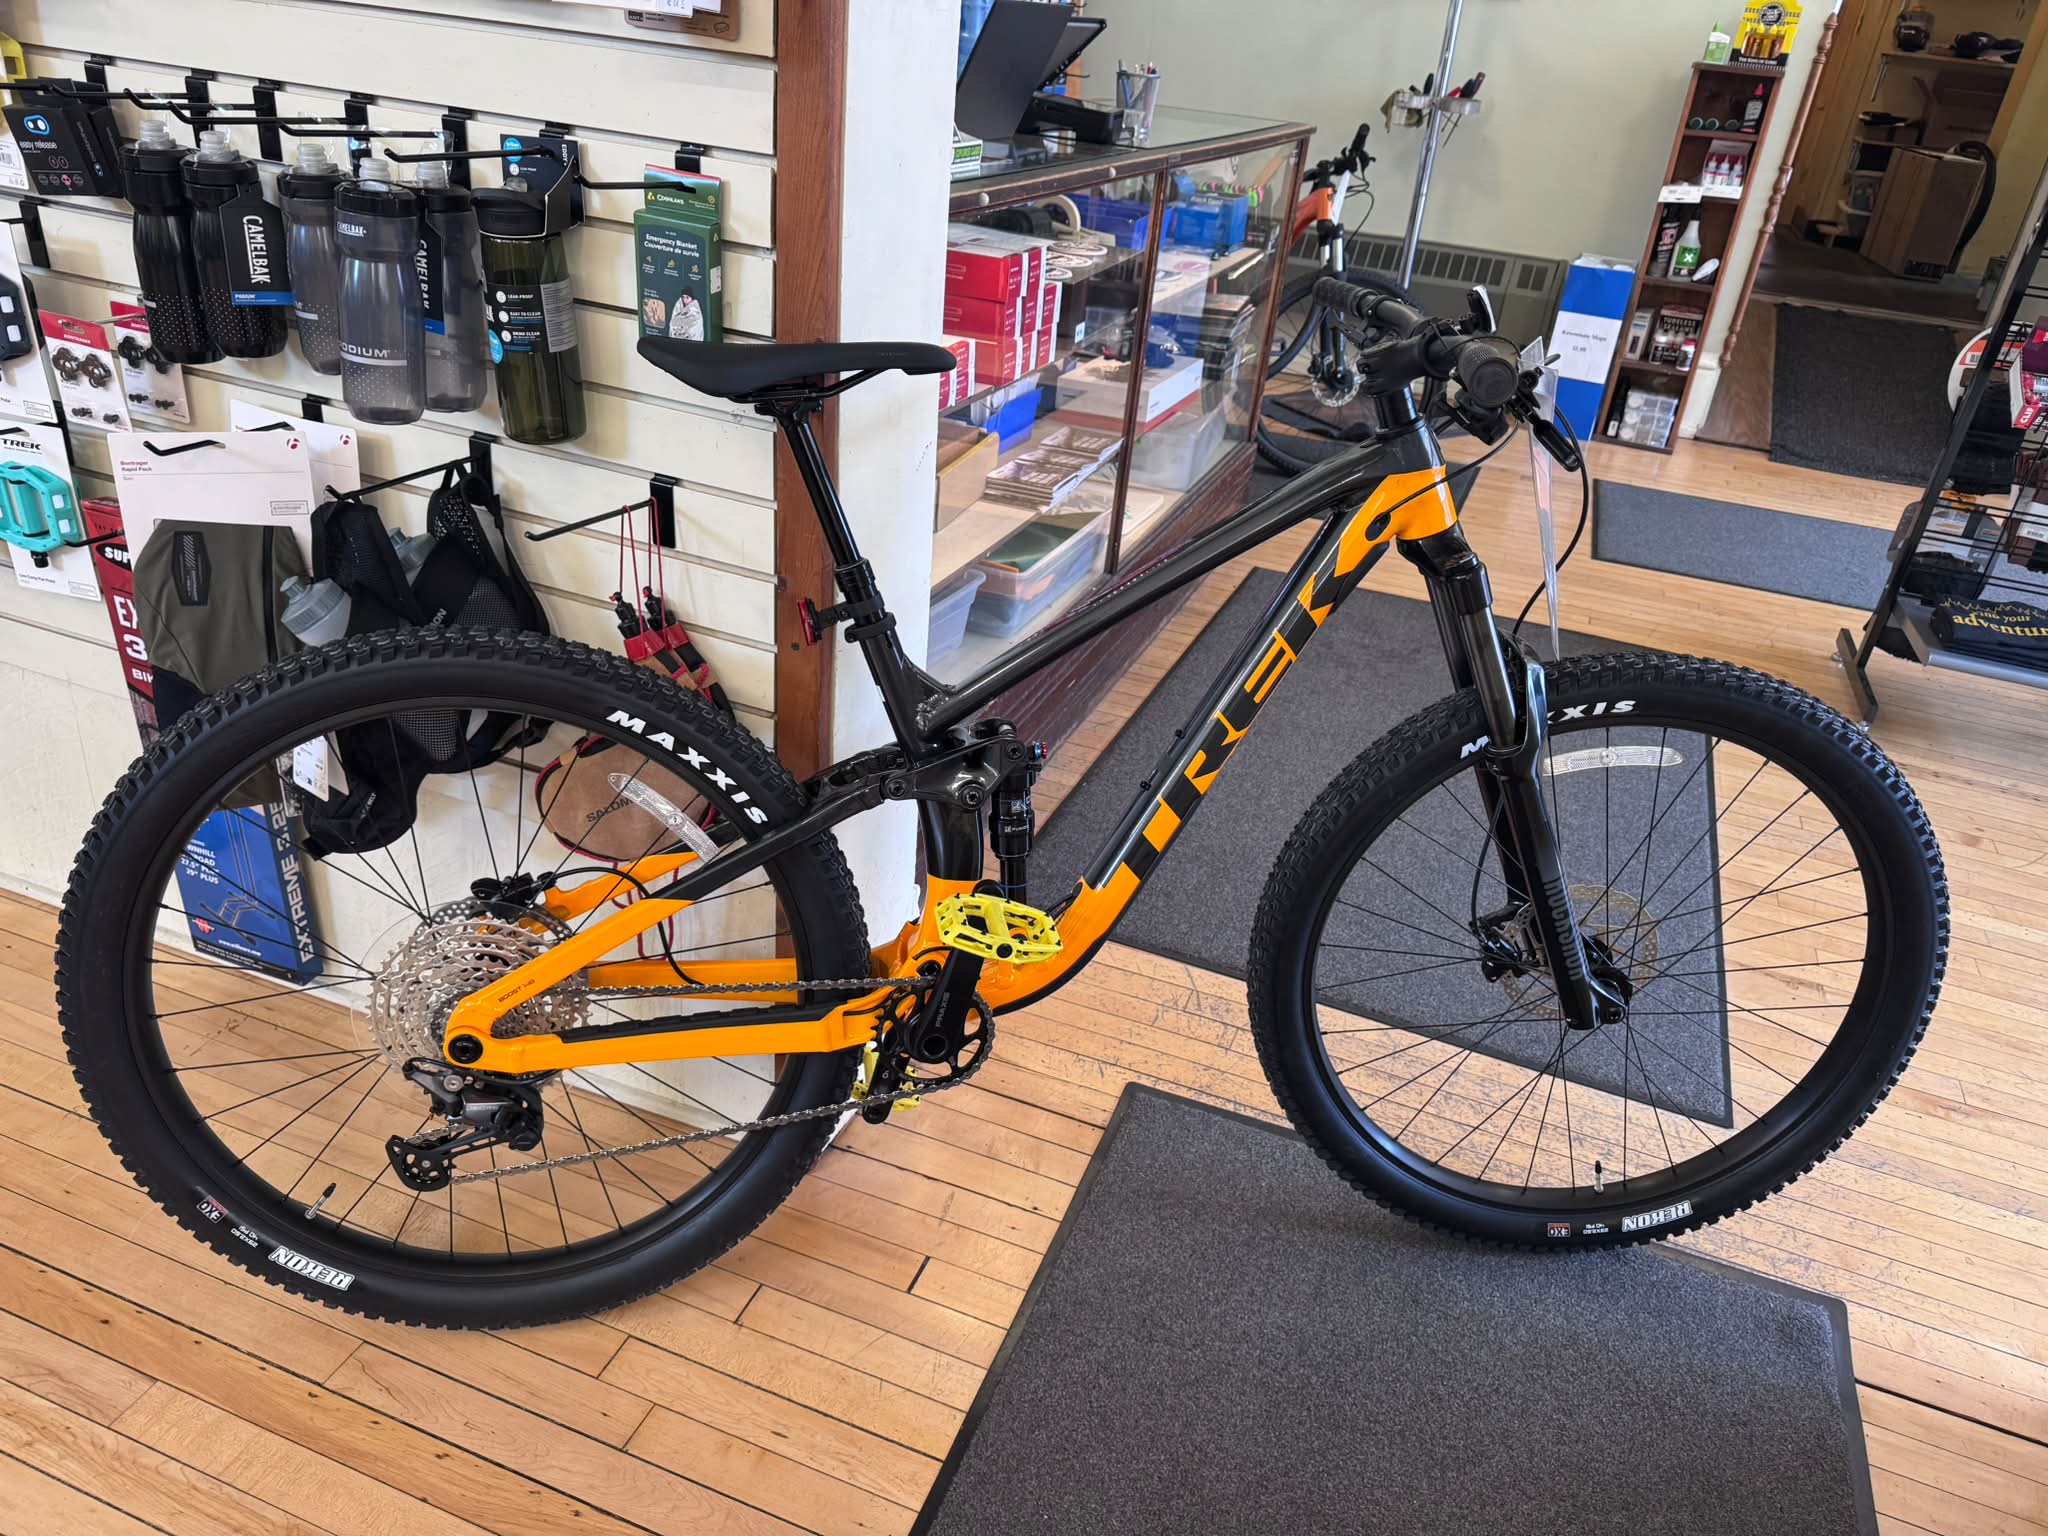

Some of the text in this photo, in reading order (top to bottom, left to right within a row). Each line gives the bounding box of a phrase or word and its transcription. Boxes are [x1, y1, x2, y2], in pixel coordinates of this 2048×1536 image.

[242, 215, 271, 284] CAMELBAK
[644, 240, 674, 252] Couverture
[682, 250, 699, 258] survie
[645, 233, 675, 246] Emergency
[676, 239, 698, 250] Blanket
[340, 343, 389, 358] ODIUM
[2, 438, 42, 451] TREK
[1952, 612, 2048, 637] adventur
[2002, 615, 2032, 624] your
[605, 709, 768, 825] MAXXIS
[585, 796, 633, 823] SALOM
[200, 872, 219, 885] PLUS
[281, 853, 314, 962] EXTREME
[498, 986, 521, 1002] BOOST
[935, 992, 950, 1027] PRAXIS
[199, 1201, 222, 1220] EXO
[1622, 1200, 1693, 1232] REKON
[1550, 1227, 1570, 1237] EXO
[269, 1246, 356, 1291] REKON
